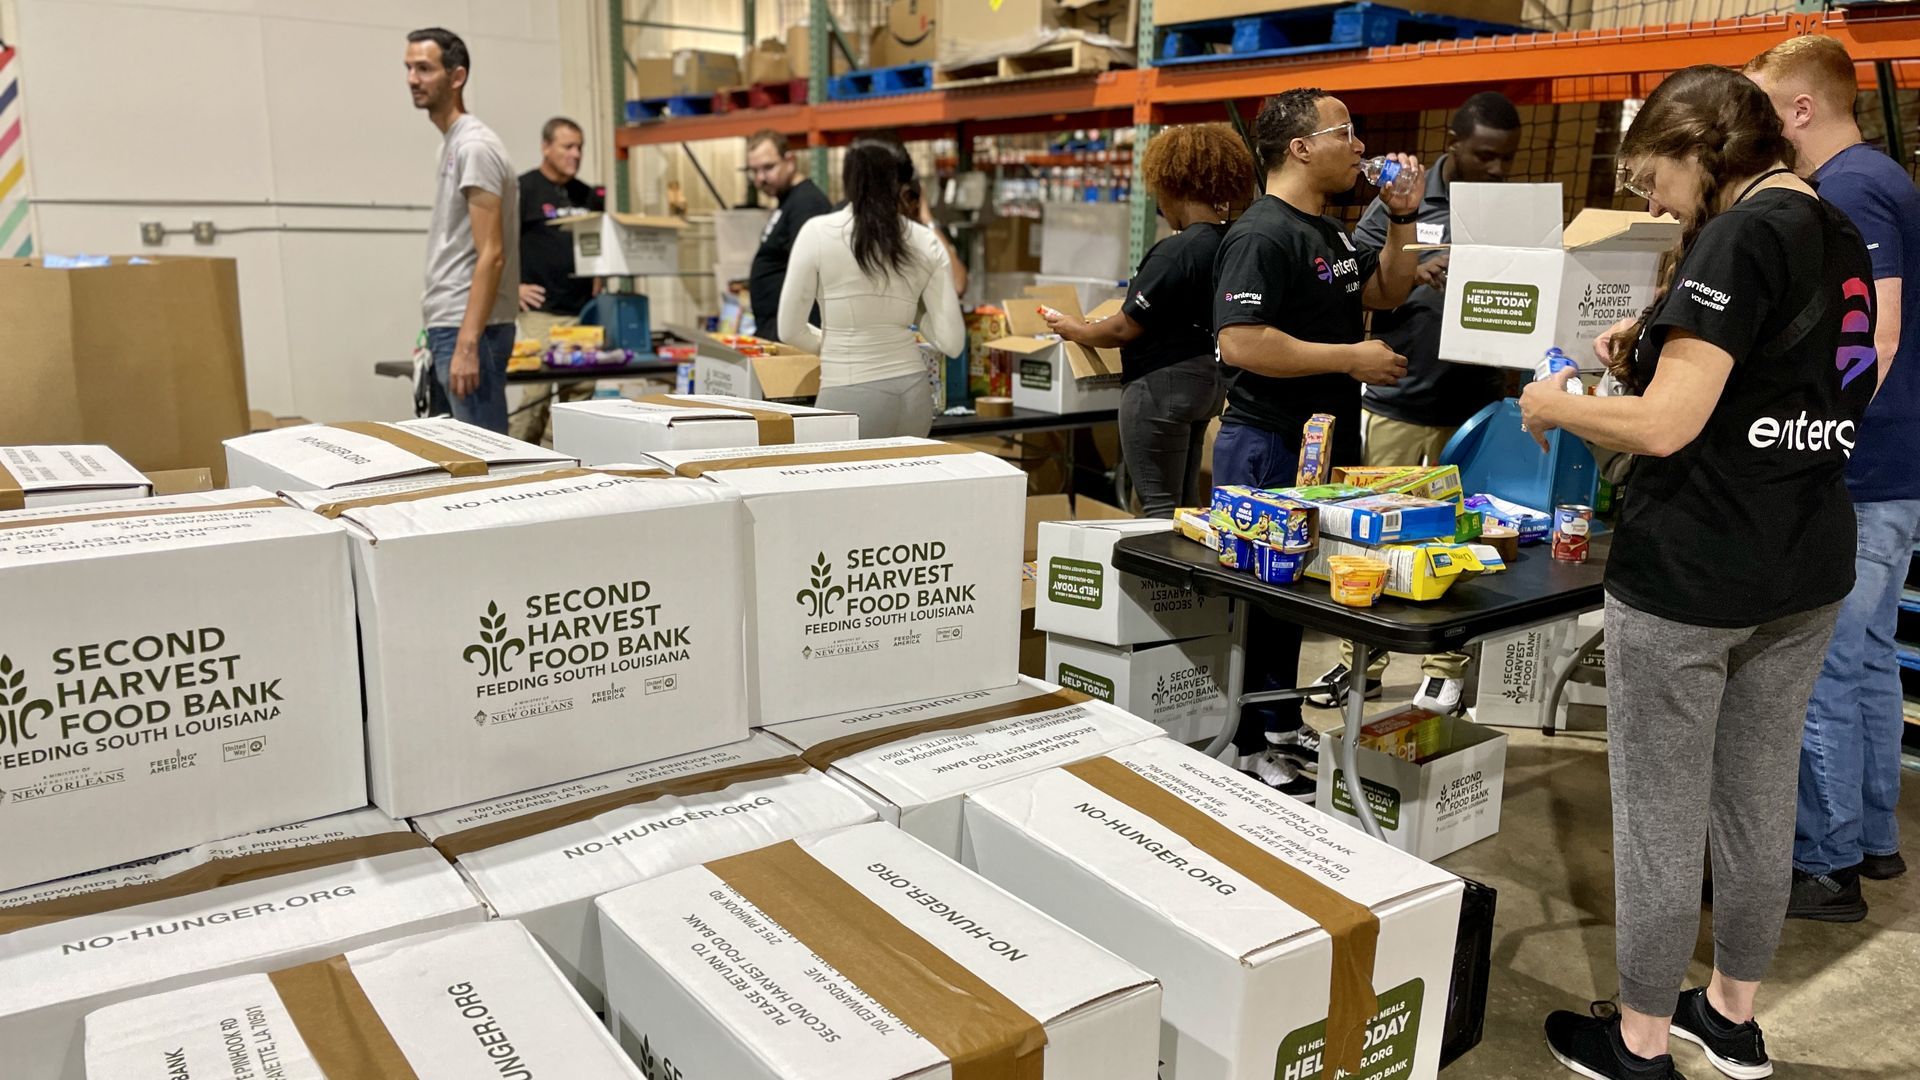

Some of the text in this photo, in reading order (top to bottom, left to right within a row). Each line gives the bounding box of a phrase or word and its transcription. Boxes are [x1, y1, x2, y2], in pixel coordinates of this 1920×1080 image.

[1332, 258, 1359, 277] enterg
[1233, 291, 1262, 301] entergy
[1467, 295, 1532, 308] HELP TODAY
[1595, 296, 1632, 307] HARVEST
[1596, 283, 1630, 295] SECOND
[1684, 279, 1731, 305] entergy
[1691, 293, 1725, 311] VOLUNTEER
[1473, 307, 1523, 317] NO-HUNGER.ORG
[1483, 317, 1503, 325] HARVEST
[1593, 308, 1638, 319] FOOD BANK
[1747, 410, 1856, 460] enterg
[780, 459, 942, 476] NO-HUNGER.ORG
[846, 540, 947, 570] SECOND
[847, 563, 954, 594] HARVEST
[1053, 581, 1079, 593] TODAY
[1079, 585, 1100, 597] HELP
[526, 580, 651, 618] SECOND
[847, 583, 977, 617] FOOD BANK
[1150, 589, 1192, 601] HARVEST
[1153, 599, 1193, 612] SECOND
[528, 604, 662, 646] HARVEST
[804, 604, 975, 636] FEEDING SOUTH LOUISIANA
[52, 627, 226, 675] SECOND
[529, 625, 692, 672] FOOD BANK
[814, 641, 880, 659] NEW ORLEANS
[1523, 632, 1537, 686] FOOD BANK
[476, 648, 691, 698] FEEDING SOUTH LOUISIANA
[1169, 665, 1209, 682] SECOND
[1503, 643, 1516, 685] SECOND
[1513, 641, 1525, 686] HARVEST
[57, 654, 241, 708] HARVEST
[1061, 675, 1083, 690] HELP
[1083, 682, 1111, 700] TODAY
[1169, 675, 1213, 694] HARVEST
[1169, 683, 1220, 704] FOOD BANK
[60, 678, 285, 740] FOOD BANK
[491, 710, 518, 723] NEW
[520, 699, 574, 717] ORLEANS
[591, 692, 626, 704] AMERICA
[840, 690, 993, 725] NO-HUNGER.ORG
[1153, 693, 1219, 714] FEEDING SOUTH LOUISIANA
[96, 706, 282, 752] SOUTH LOUISIANA
[985, 706, 1087, 735] NEW 70123
[1007, 727, 1028, 738] AVE
[150, 752, 196, 768] FEEDING
[224, 742, 247, 754] United
[233, 749, 247, 758] Way
[711, 754, 742, 764] 70501
[877, 745, 920, 762] LA 70501
[894, 757, 911, 767] RD
[911, 744, 954, 762] PINHOOK
[932, 726, 1097, 774] SECOND HARVEST FOOD BANK
[977, 738, 1080, 770] PLEASE RETURN TO
[150, 761, 196, 776] AMERICA
[658, 756, 711, 771] PINHOOK
[11, 786, 48, 801] NEW
[51, 771, 125, 793] ORLEANS
[1122, 760, 1228, 818] NEW LA 70123
[1145, 763, 1228, 808] 700 EDWARDS AVE
[1451, 770, 1482, 791] SECOND
[1451, 780, 1484, 801] HARVEST
[457, 784, 610, 824] NEW LA 70123
[471, 783, 585, 815] 700 EDWARDS AVE
[1179, 763, 1356, 856] SECOND HARVEST FOOD BANK
[1218, 775, 1329, 835] PLEASE RETURN TO
[1449, 787, 1490, 811] FOOD BANK
[563, 795, 775, 859] NO-HUNGER.ORG
[1436, 811, 1455, 823] FEEDING
[1455, 805, 1468, 815] SOUTH
[208, 831, 345, 856] 215 PINHOOK RD
[1073, 802, 1237, 896] NO-HUNGER.ORG
[1238, 823, 1345, 882] LAFAYETTE, LA 70501
[1256, 824, 1351, 874] 215 E PINHOOK RD
[1, 873, 155, 905] 700 EDWARDS AVE
[62, 885, 358, 957] NO-HUNGER.ORG
[708, 889, 782, 946] 215 E PINHOOK RD
[866, 862, 1028, 962] NO-HUNGER.ORG
[690, 942, 711, 958] TO
[682, 914, 842, 1043] SECOND HARVEST FOOD BANK
[705, 954, 752, 991] RETURN
[745, 987, 791, 1026] PLEASE
[803, 967, 895, 1036] 700 EDWARDS AVE
[245, 1005, 272, 1044] LA 70501
[1297, 1001, 1406, 1056] $1 MEALS
[220, 1018, 252, 1074] PINHOOK RD
[1384, 1058, 1409, 1077] BANK
